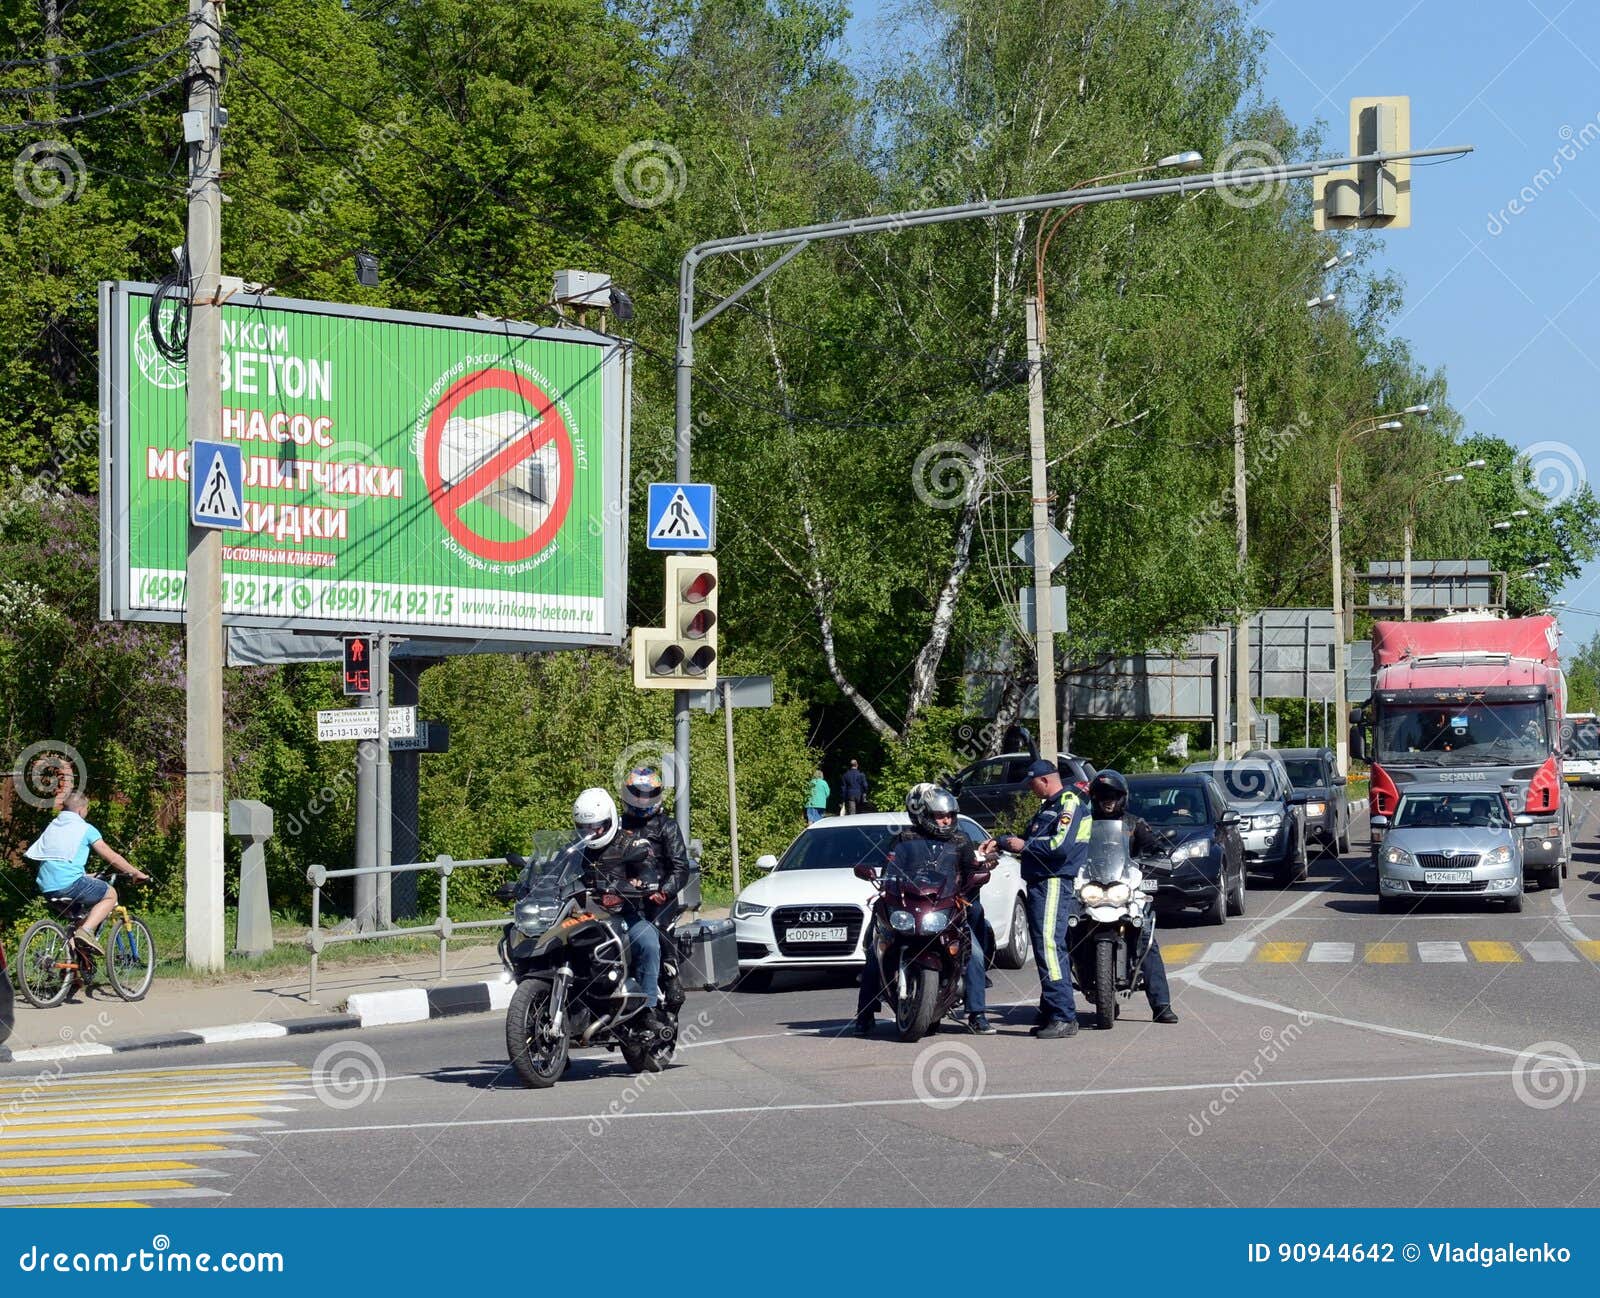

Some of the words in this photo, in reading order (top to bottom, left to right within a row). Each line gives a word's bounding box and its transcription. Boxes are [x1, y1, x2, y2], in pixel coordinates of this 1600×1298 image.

[220, 319, 288, 352] NKOM
[221, 407, 334, 447] НАСОС
[241, 501, 348, 543] КИДКИ
[440, 536, 487, 570] Доллары
[489, 565, 501, 574] не
[234, 580, 256, 605] 92
[263, 583, 284, 607] 14
[320, 586, 365, 614] (499)
[369, 590, 401, 615] 714
[406, 592, 427, 615] 92
[434, 593, 453, 617] 15
[461, 600, 594, 622] www.inkom-beton.ru
[346, 670, 369, 690] 46
[1440, 772, 1487, 783] SCANIA
